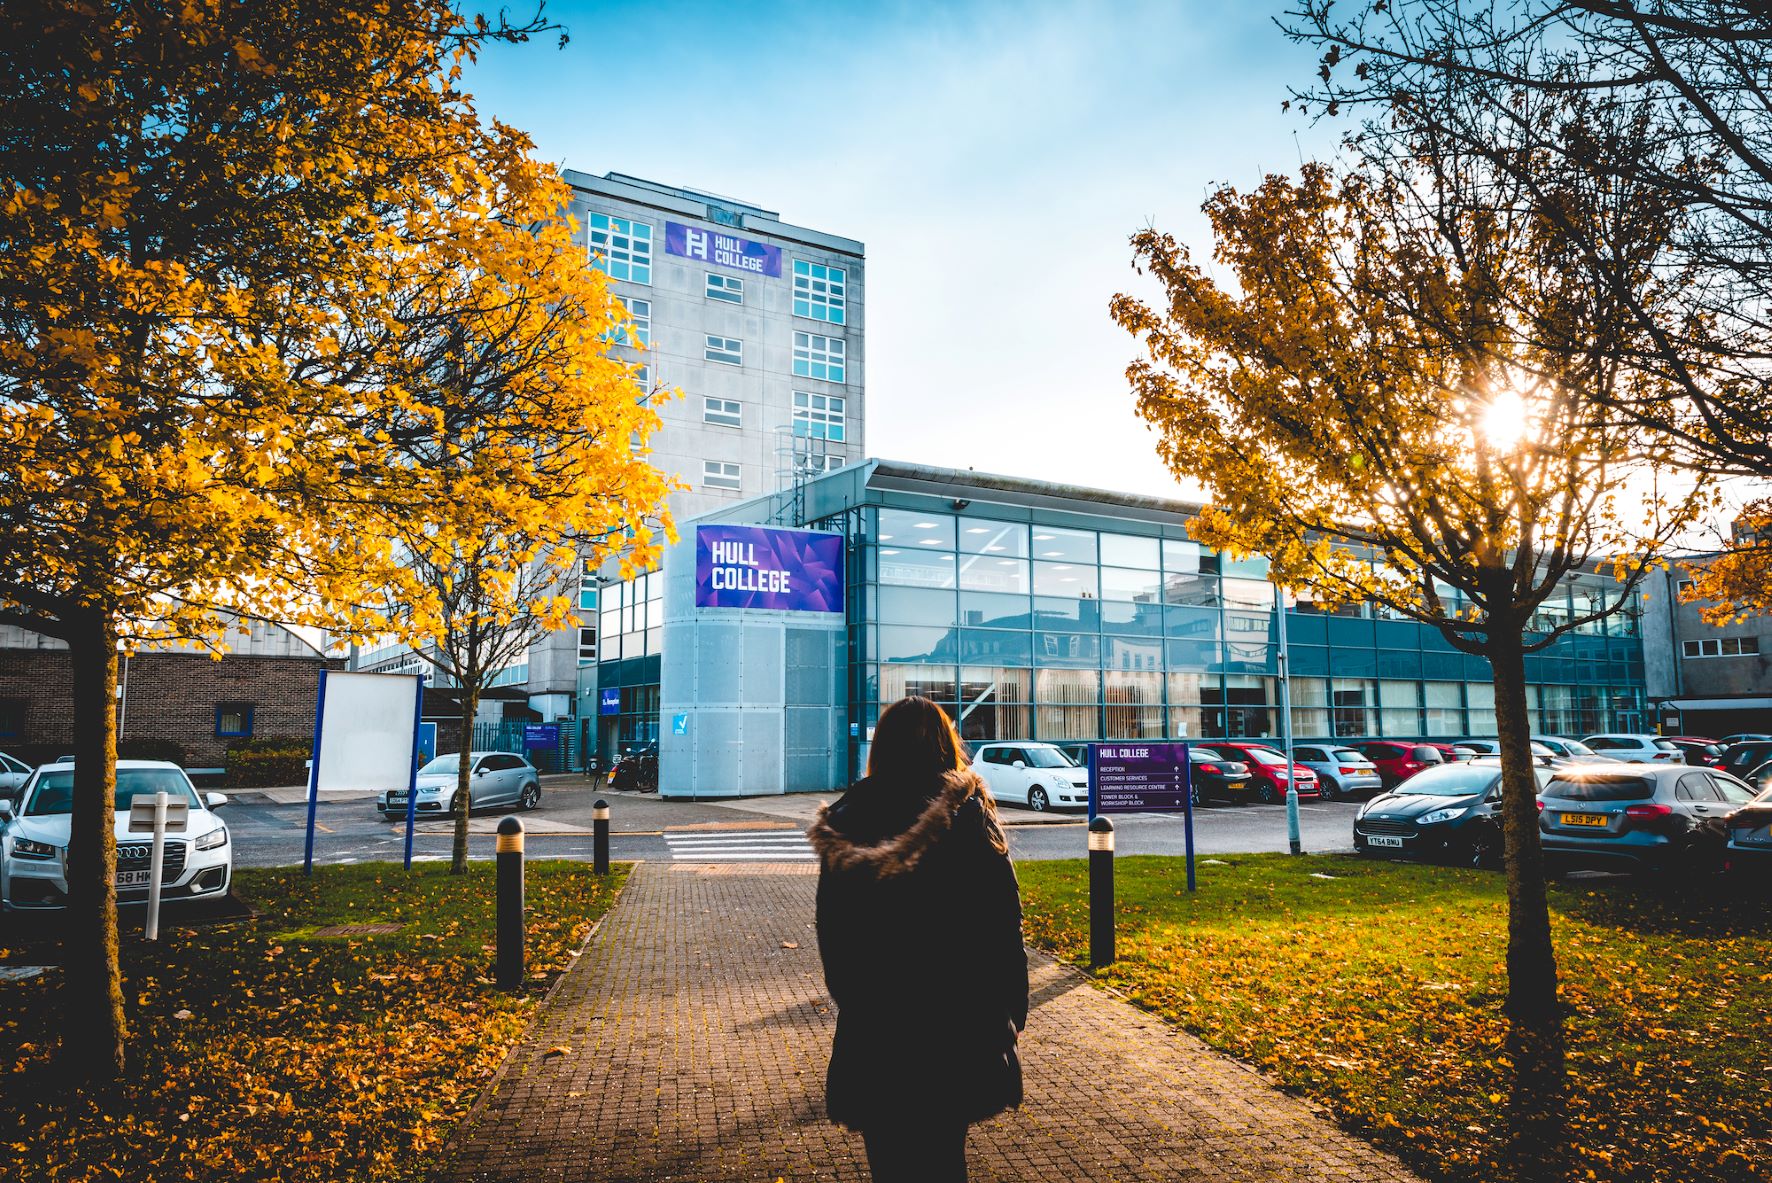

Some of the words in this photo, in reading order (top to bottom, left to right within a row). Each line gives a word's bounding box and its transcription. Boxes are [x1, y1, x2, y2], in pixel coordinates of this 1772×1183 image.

[715, 235, 743, 254] HULL
[715, 250, 763, 272] COLLEGE
[712, 541, 758, 565] HULL
[712, 567, 791, 593] COLLEGE
[1100, 748, 1117, 758] HULL
[1119, 748, 1149, 758] COLLEGE
[117, 872, 133, 884] 68
